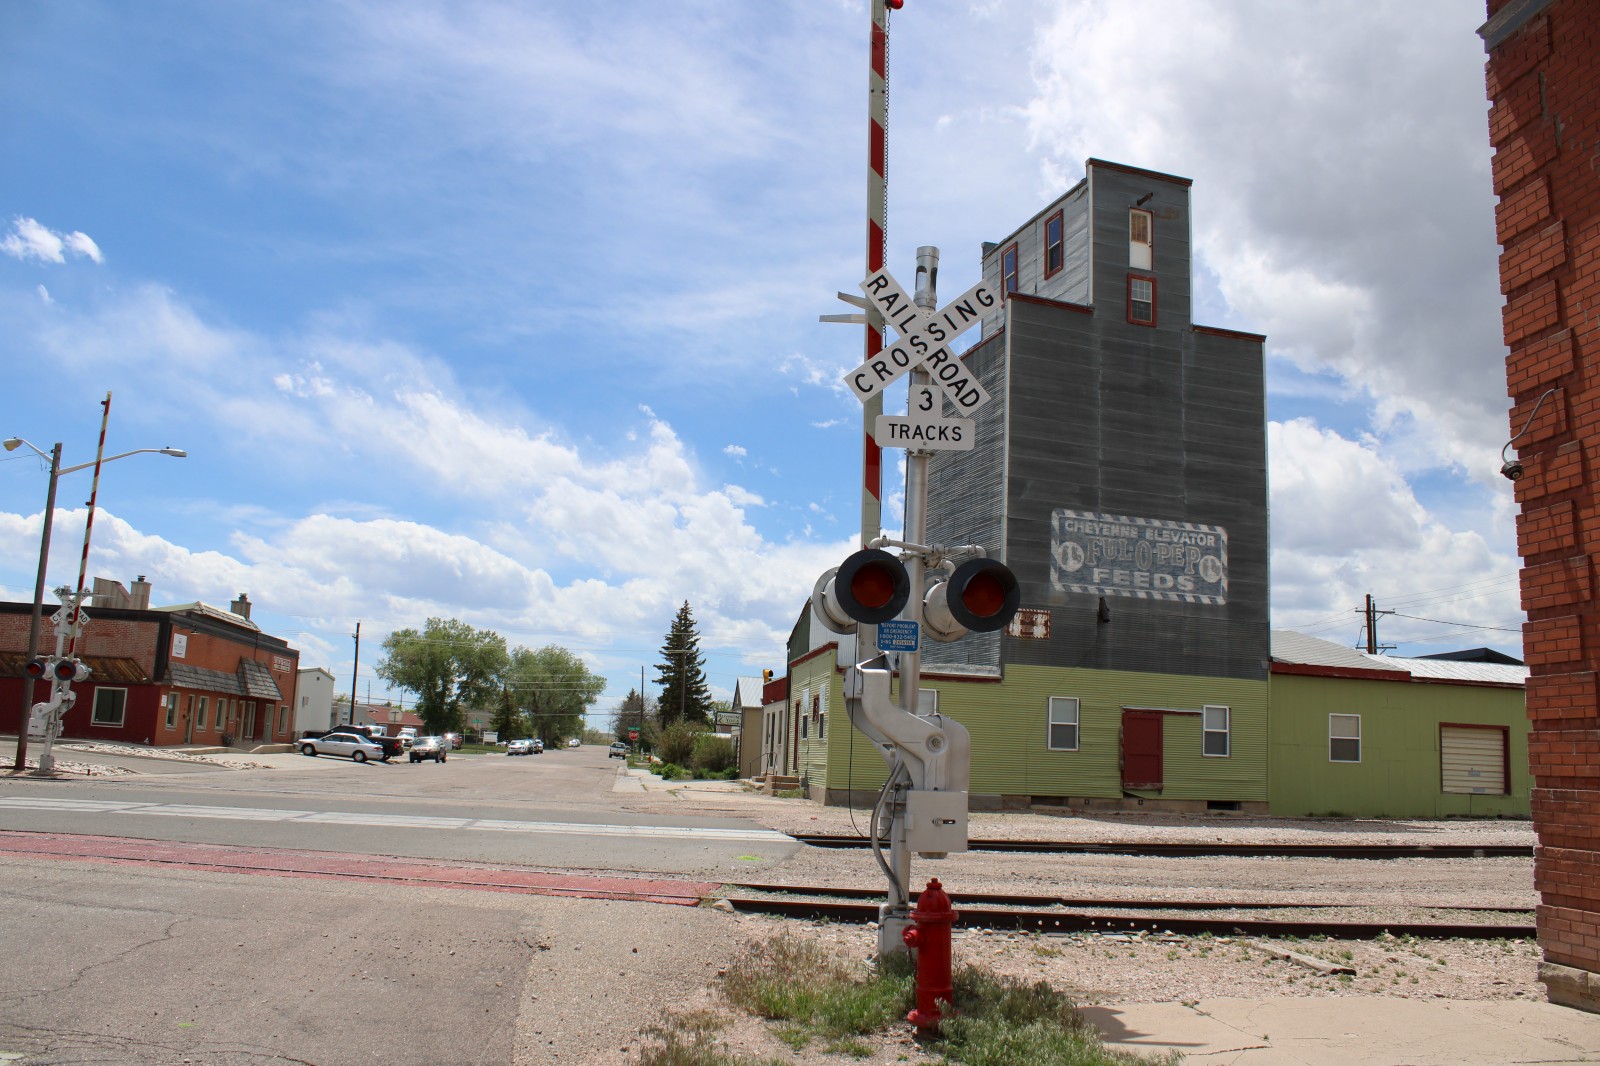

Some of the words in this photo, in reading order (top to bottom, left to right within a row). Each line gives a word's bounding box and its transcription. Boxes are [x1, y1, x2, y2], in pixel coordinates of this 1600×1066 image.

[855, 288, 994, 393] CROSSING
[867, 274, 979, 407] RAILROAD
[918, 391, 933, 411] 3
[889, 423, 962, 441] TRACKS
[1065, 520, 1139, 538] CHEYENNE
[1145, 528, 1215, 547] ELEVATOR
[1093, 568, 1195, 591] FEEDS
